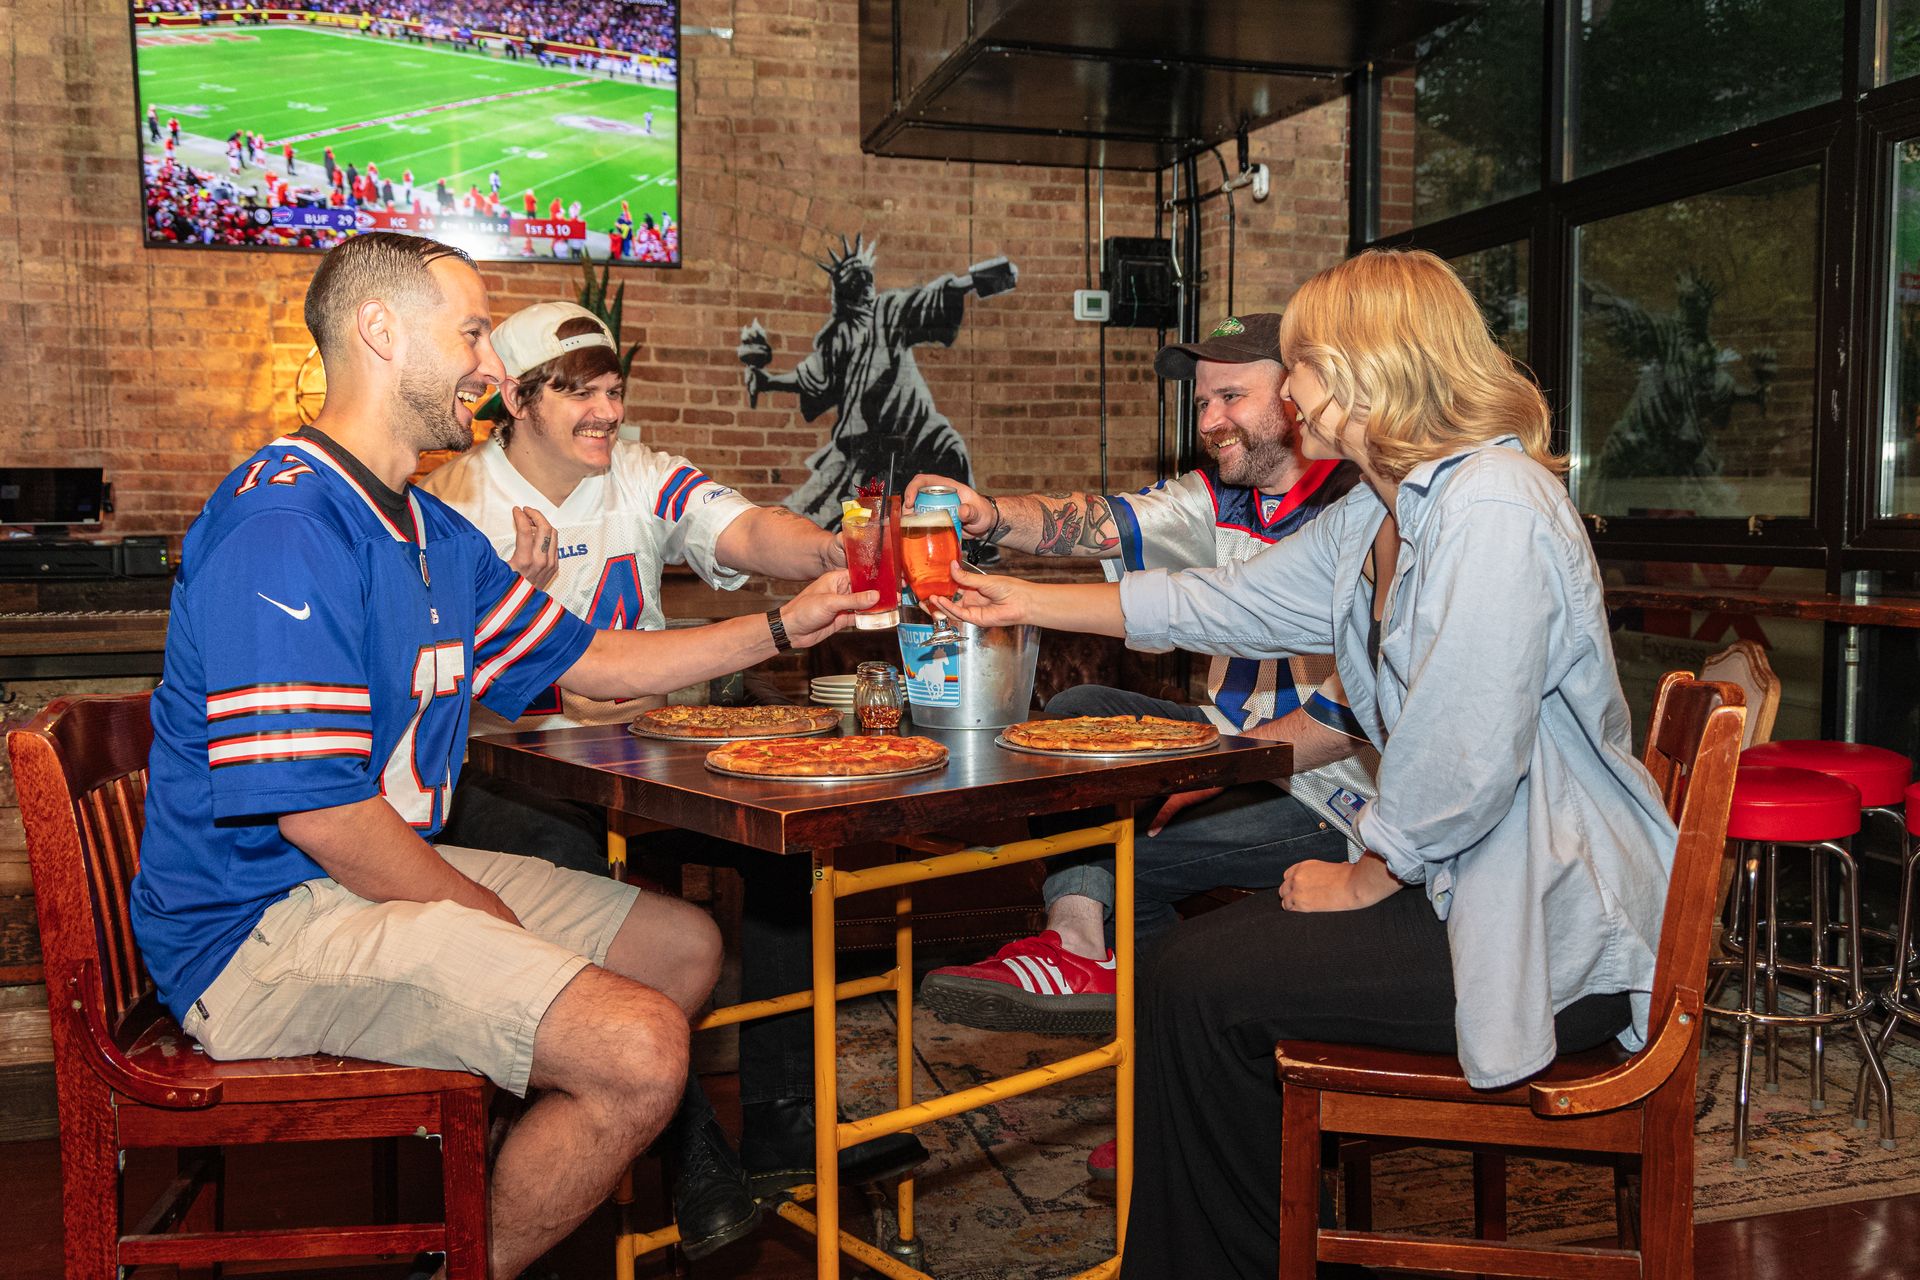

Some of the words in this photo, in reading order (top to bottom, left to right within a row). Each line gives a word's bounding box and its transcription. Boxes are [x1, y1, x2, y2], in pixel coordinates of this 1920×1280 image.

[304, 214, 329, 224] BUF
[337, 215, 352, 226] 29
[390, 217, 407, 228] KC
[545, 223, 555, 235] &
[556, 224, 571, 235] 10
